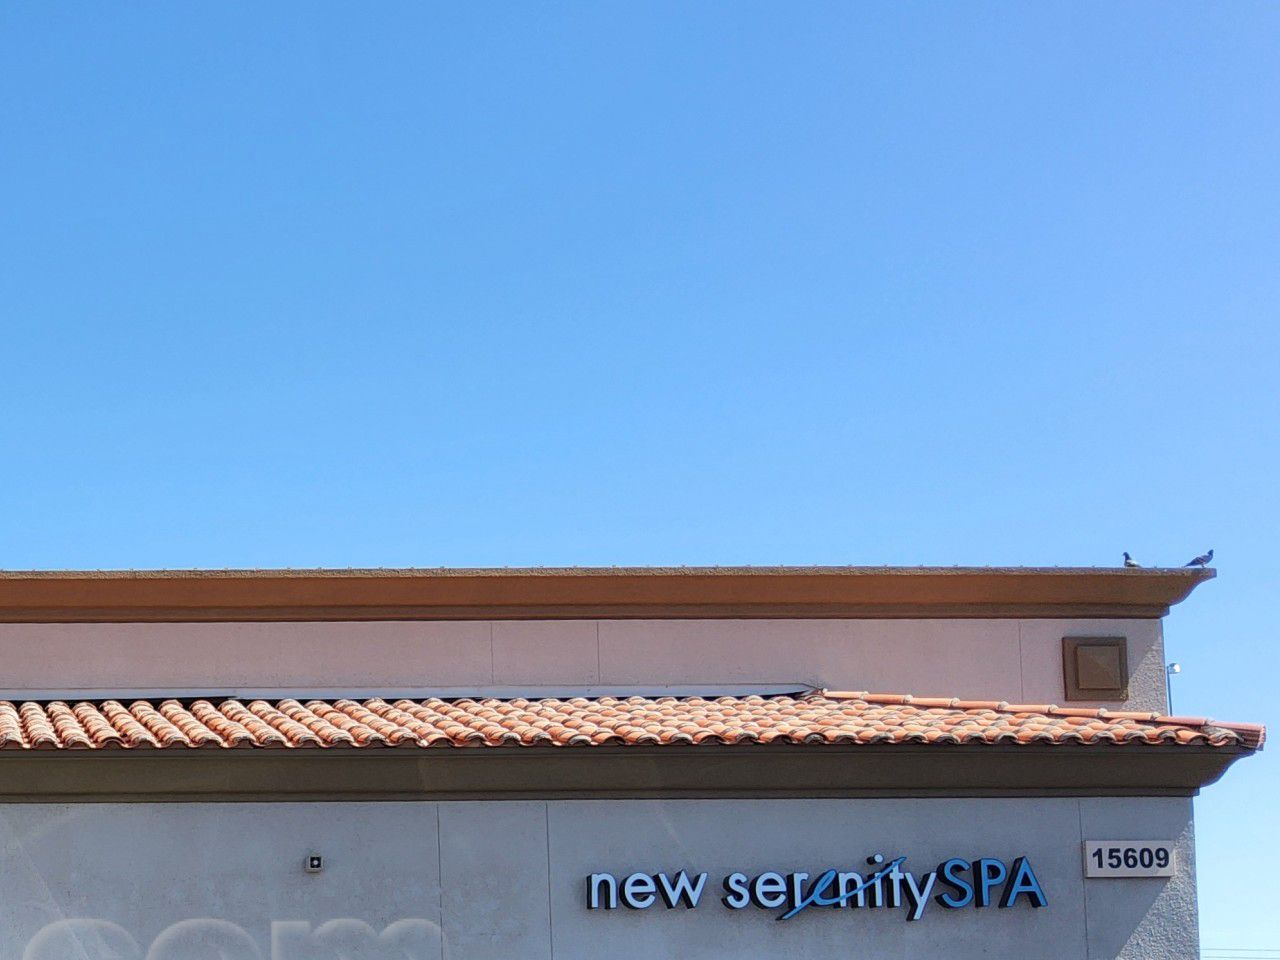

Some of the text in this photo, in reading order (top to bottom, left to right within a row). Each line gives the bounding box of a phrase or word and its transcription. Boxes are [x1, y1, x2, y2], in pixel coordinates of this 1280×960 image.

[1092, 847, 1170, 869] 15609
[588, 854, 1048, 921] new serenity SPA
